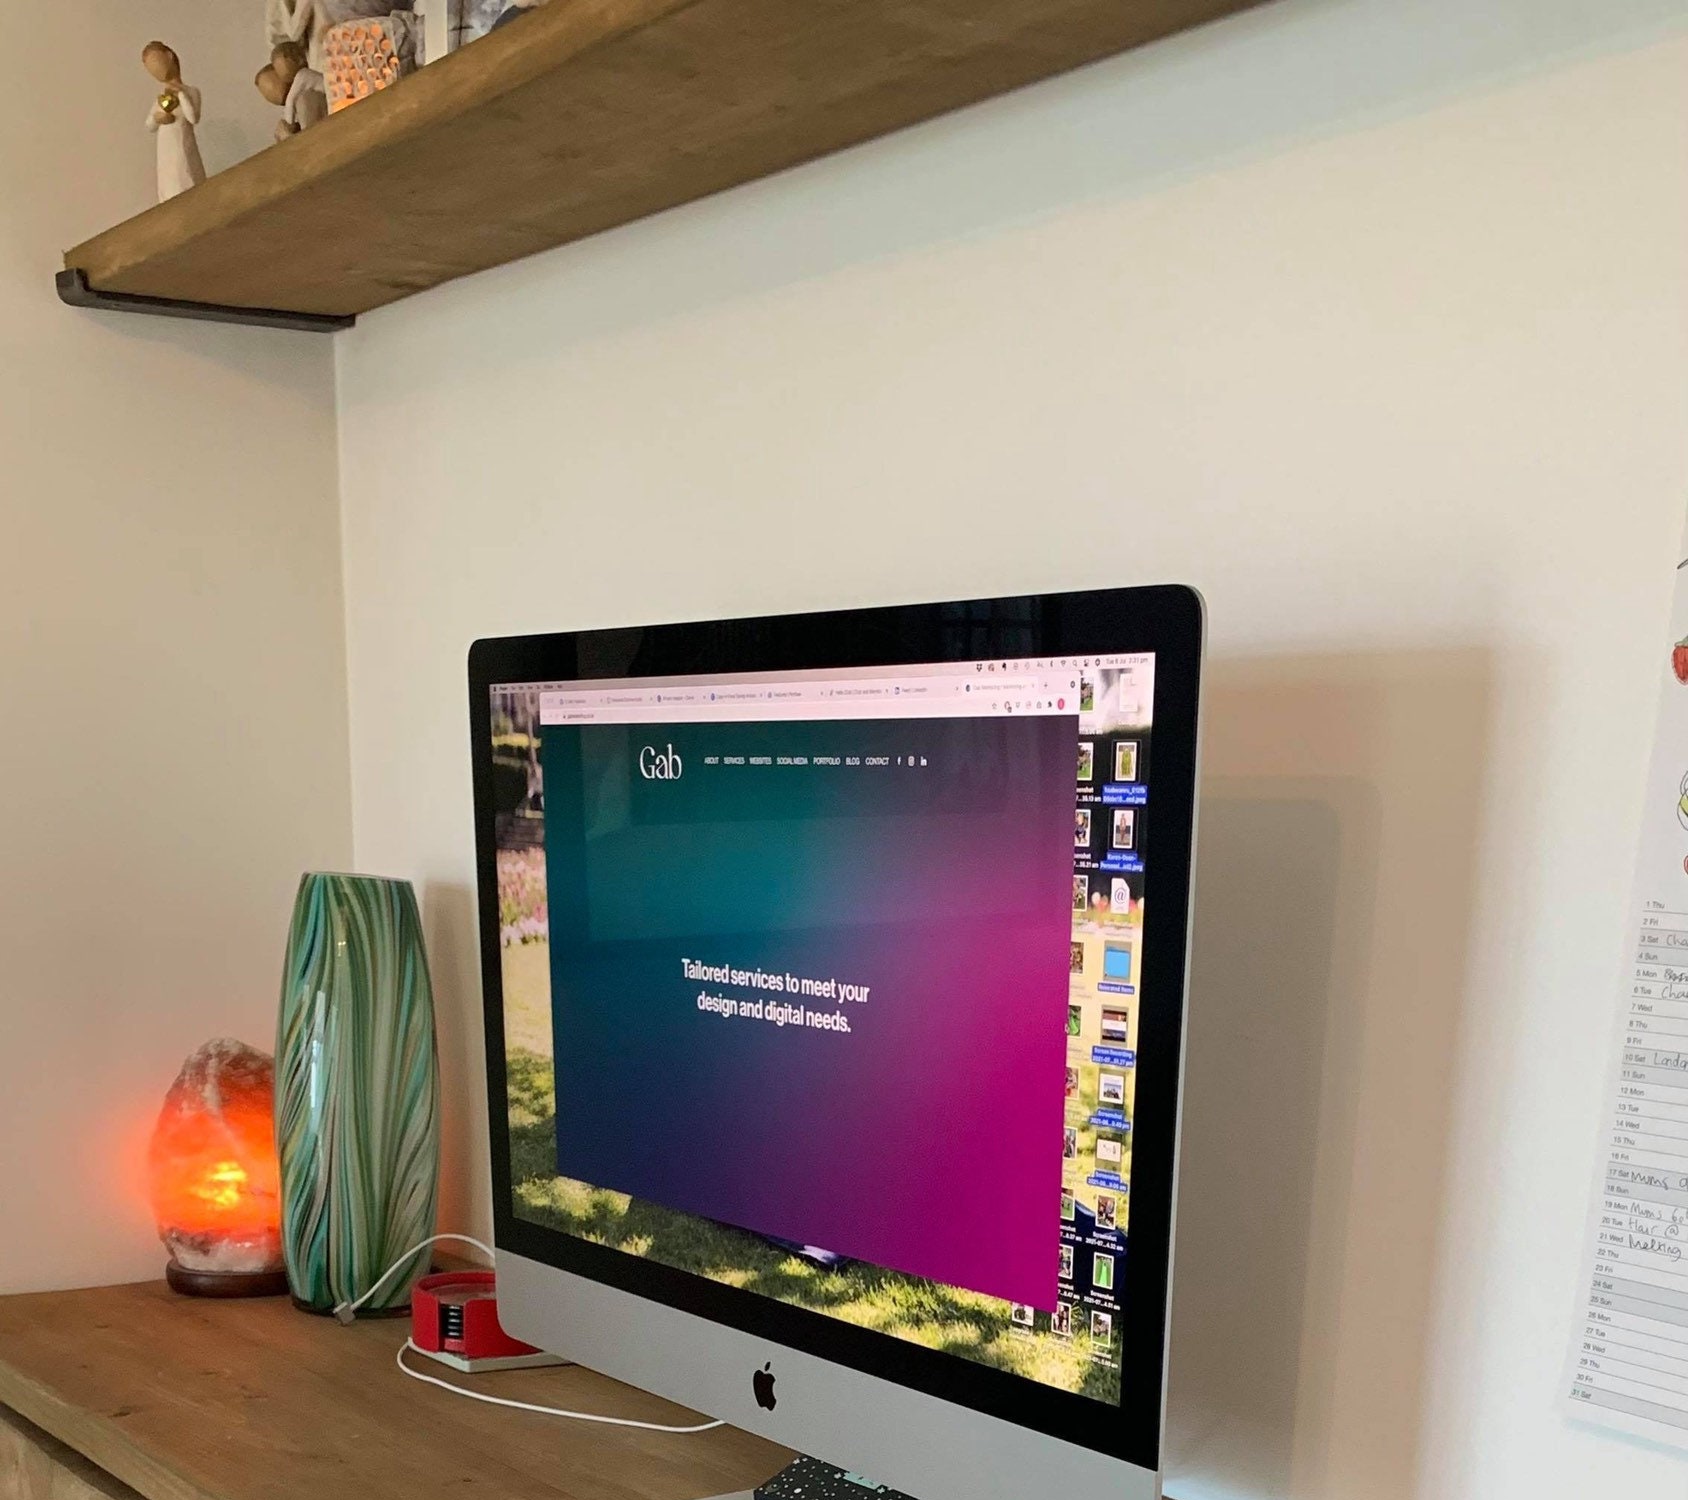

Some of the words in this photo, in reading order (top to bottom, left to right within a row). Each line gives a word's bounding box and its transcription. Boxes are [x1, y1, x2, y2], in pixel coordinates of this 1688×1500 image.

[639, 743, 682, 780] Gab
[723, 757, 745, 765] SERVICES
[749, 757, 772, 765] WEBSITES
[776, 757, 793, 765] SOCIAL
[793, 757, 808, 765] MEDIA
[813, 757, 841, 765] PORTFOLIO
[846, 757, 860, 765] BLOG
[865, 757, 889, 766] CONTACT
[1652, 902, 1665, 910] Thu
[1649, 918, 1659, 926] Fri
[1647, 935, 1659, 944] Sat
[1645, 952, 1658, 961] Sun
[1642, 969, 1657, 978] Mon
[681, 958, 729, 984] Tailored
[730, 968, 784, 992] services
[785, 973, 800, 993] to
[801, 978, 836, 999] meet
[837, 983, 870, 1004] your
[1640, 986, 1652, 995] Tue
[697, 991, 738, 1019] design
[739, 999, 763, 1020] and
[764, 1000, 804, 1027] digital
[806, 1011, 851, 1033] needs.
[1637, 1004, 1653, 1012] Wed
[1635, 1021, 1648, 1029] Thu
[1632, 1037, 1642, 1045] Fri
[1624, 1053, 1634, 1062] 10
[1634, 1054, 1646, 1063] Sat
[1623, 1070, 1630, 1078] 11
[1632, 1071, 1646, 1080] Sun
[1620, 1086, 1629, 1095] 12
[1630, 1087, 1645, 1096] Mon
[1618, 1103, 1627, 1112] 13
[1627, 1104, 1639, 1113] Tue
[1616, 1120, 1624, 1128] 14
[1625, 1121, 1640, 1129] Wed
[1613, 1135, 1622, 1144] 15
[1623, 1137, 1635, 1146] Thu
[1611, 1152, 1619, 1161] 16
[1620, 1153, 1629, 1161] Fri
[1609, 1168, 1617, 1176] 17
[1618, 1169, 1629, 1178] Sat
[1607, 1185, 1615, 1193] 18
[1616, 1186, 1629, 1195] Sun
[1605, 1201, 1613, 1209] 19
[1613, 1202, 1629, 1211] Mon
[1602, 1217, 1611, 1225] 20
[1611, 1218, 1623, 1227] Tue
[1665, 1224, 1679, 1239] @
[1600, 1232, 1608, 1240] 21
[1609, 1234, 1624, 1243] Wed
[1597, 1249, 1606, 1257] 22
[1607, 1250, 1619, 1259] Thu
[1595, 1264, 1604, 1273] 23
[1593, 1281, 1601, 1289] 24
[1602, 1282, 1613, 1290] Sat
[1591, 1296, 1599, 1304] 25
[1600, 1298, 1612, 1307] Sun
[1588, 1312, 1597, 1320] 26
[1597, 1313, 1611, 1322] Mon
[1586, 1327, 1594, 1335] 27
[1595, 1328, 1606, 1337] Tue
[1583, 1342, 1592, 1350] 28
[1592, 1344, 1606, 1354] Wed
[1580, 1358, 1588, 1366] 29
[1589, 1359, 1600, 1369] Thu
[1576, 1373, 1585, 1382] 30
[1585, 1375, 1594, 1383] Fri
[1571, 1389, 1580, 1397] 31
[1581, 1391, 1592, 1400] Sat
